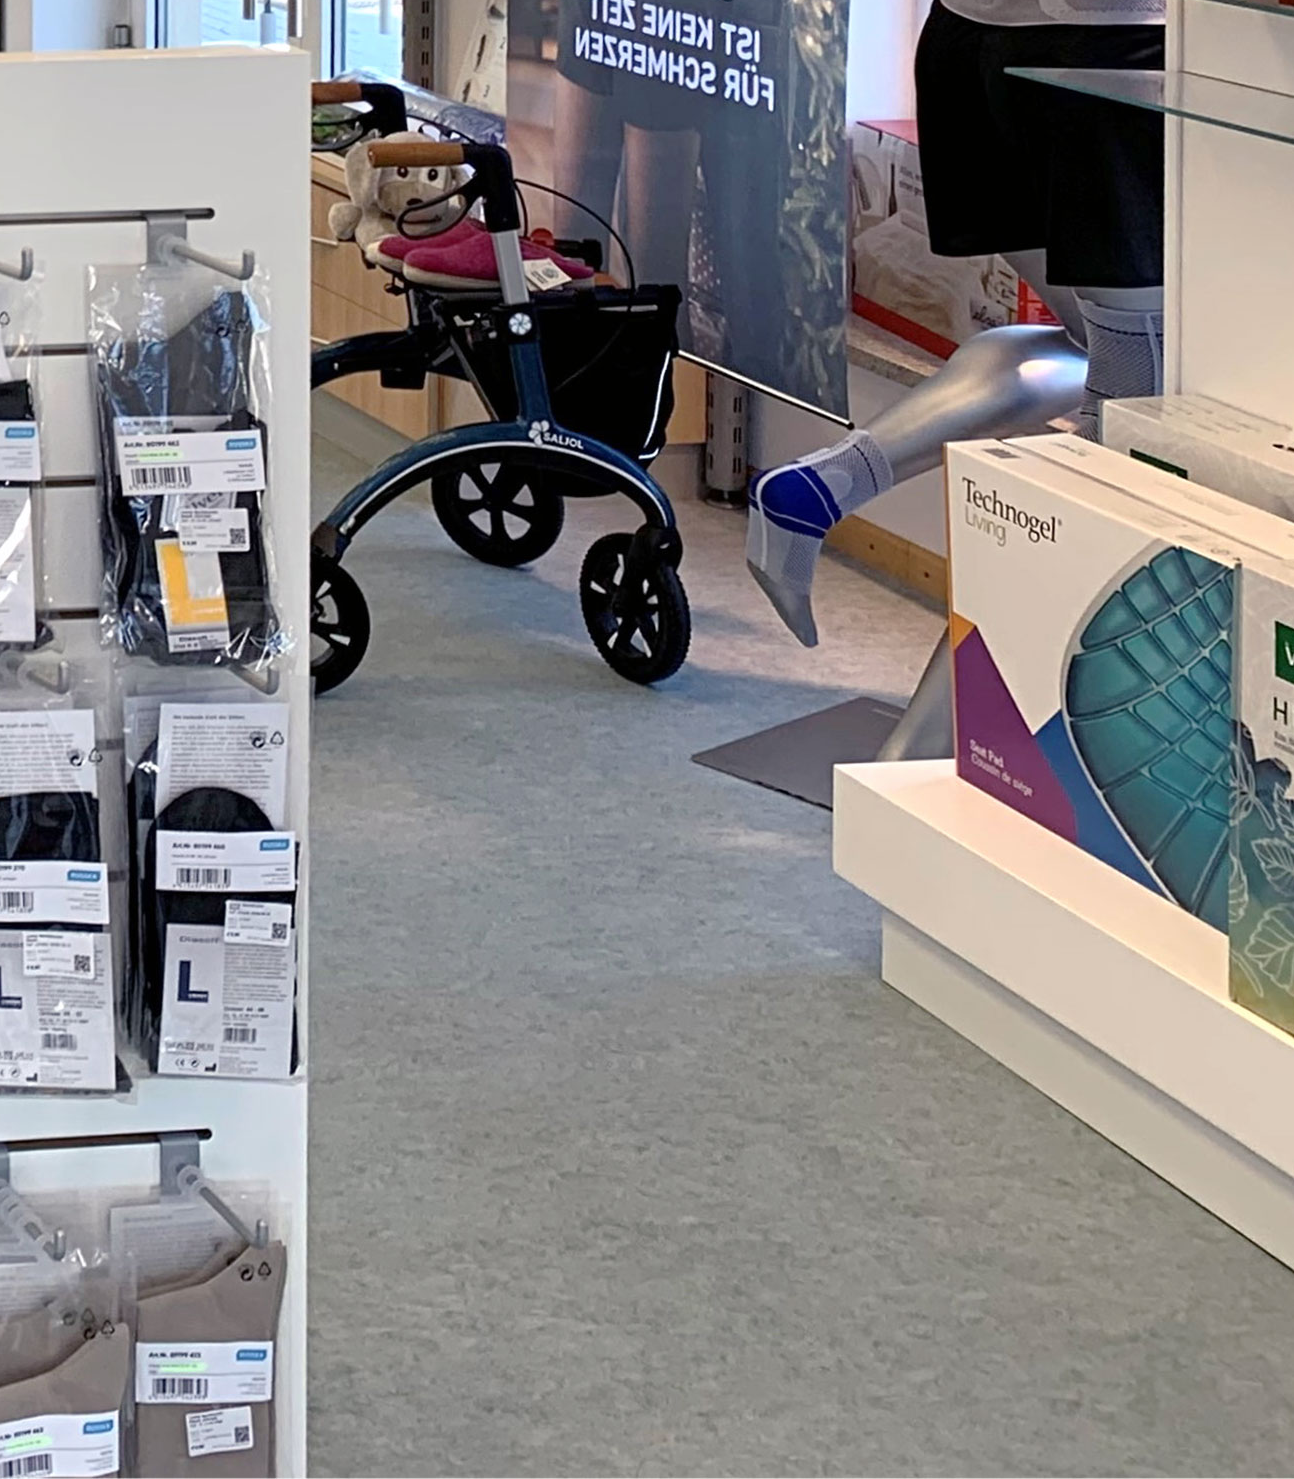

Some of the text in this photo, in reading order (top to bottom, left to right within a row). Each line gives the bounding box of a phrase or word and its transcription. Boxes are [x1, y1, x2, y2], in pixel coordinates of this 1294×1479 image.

[543, 432, 584, 450] SALJOL
[961, 476, 1058, 543] Technogel
[965, 504, 1007, 548] Living
[177, 960, 209, 1003] L
